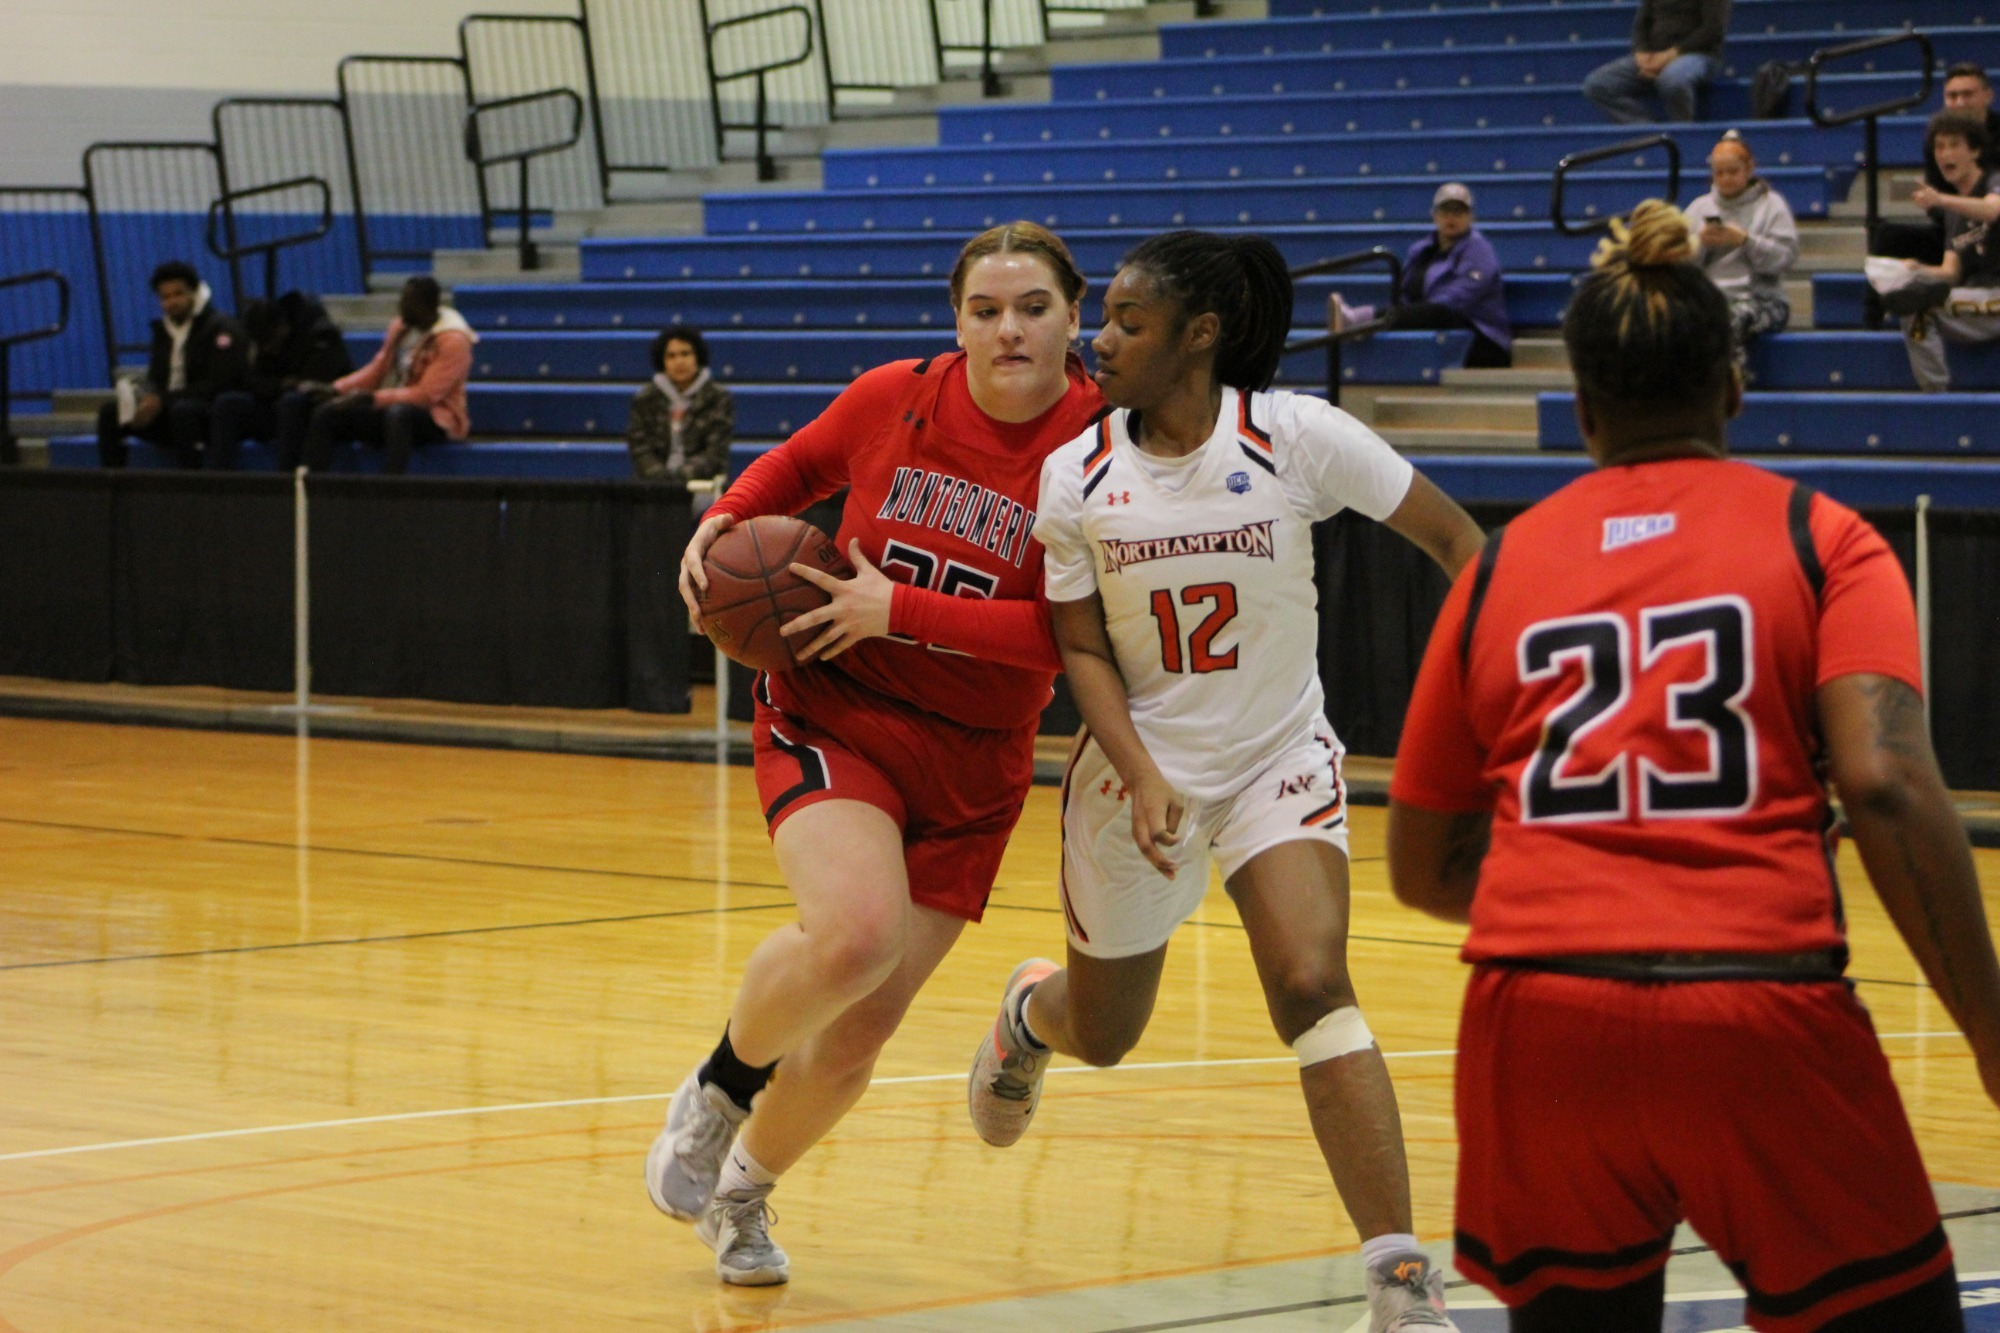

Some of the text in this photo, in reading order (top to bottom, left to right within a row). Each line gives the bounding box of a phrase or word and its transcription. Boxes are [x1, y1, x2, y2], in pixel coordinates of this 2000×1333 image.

[876, 467, 1036, 569] MONTGOMERY
[1098, 520, 1274, 574] NORTHAMPTON
[1150, 581, 1239, 674] 12
[1516, 593, 1758, 826] 23
